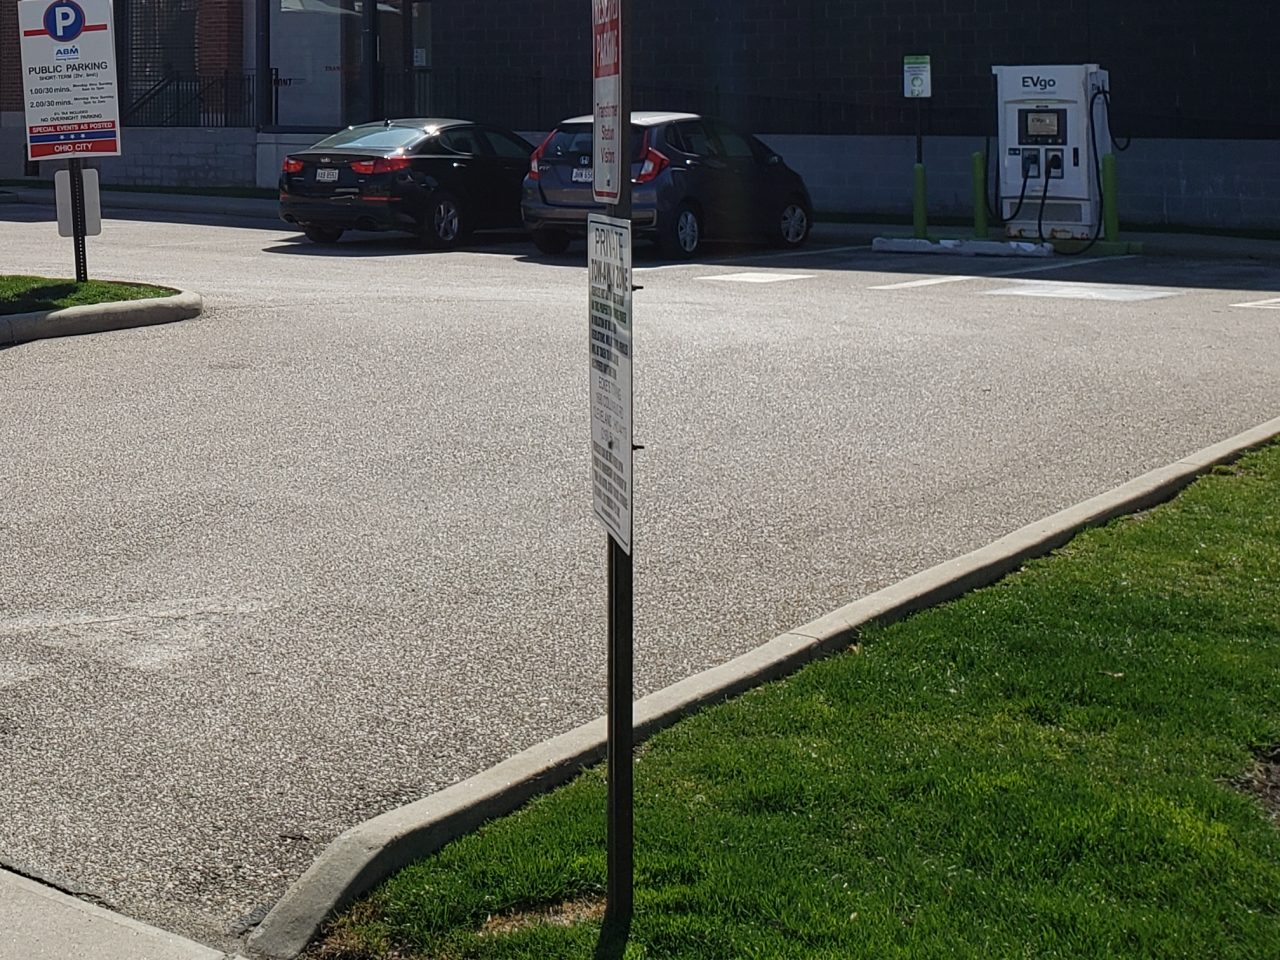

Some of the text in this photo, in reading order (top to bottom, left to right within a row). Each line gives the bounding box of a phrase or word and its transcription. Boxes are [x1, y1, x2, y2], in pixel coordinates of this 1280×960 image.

[56, 47, 79, 56] ABM
[596, 29, 618, 68] PARKING
[28, 61, 108, 75] PUBLIC PARKING
[1022, 76, 1056, 90] EVgo
[54, 143, 93, 152] OHIO CITY
[595, 227, 624, 261] PRIVATE
[615, 265, 628, 292] ZONE
